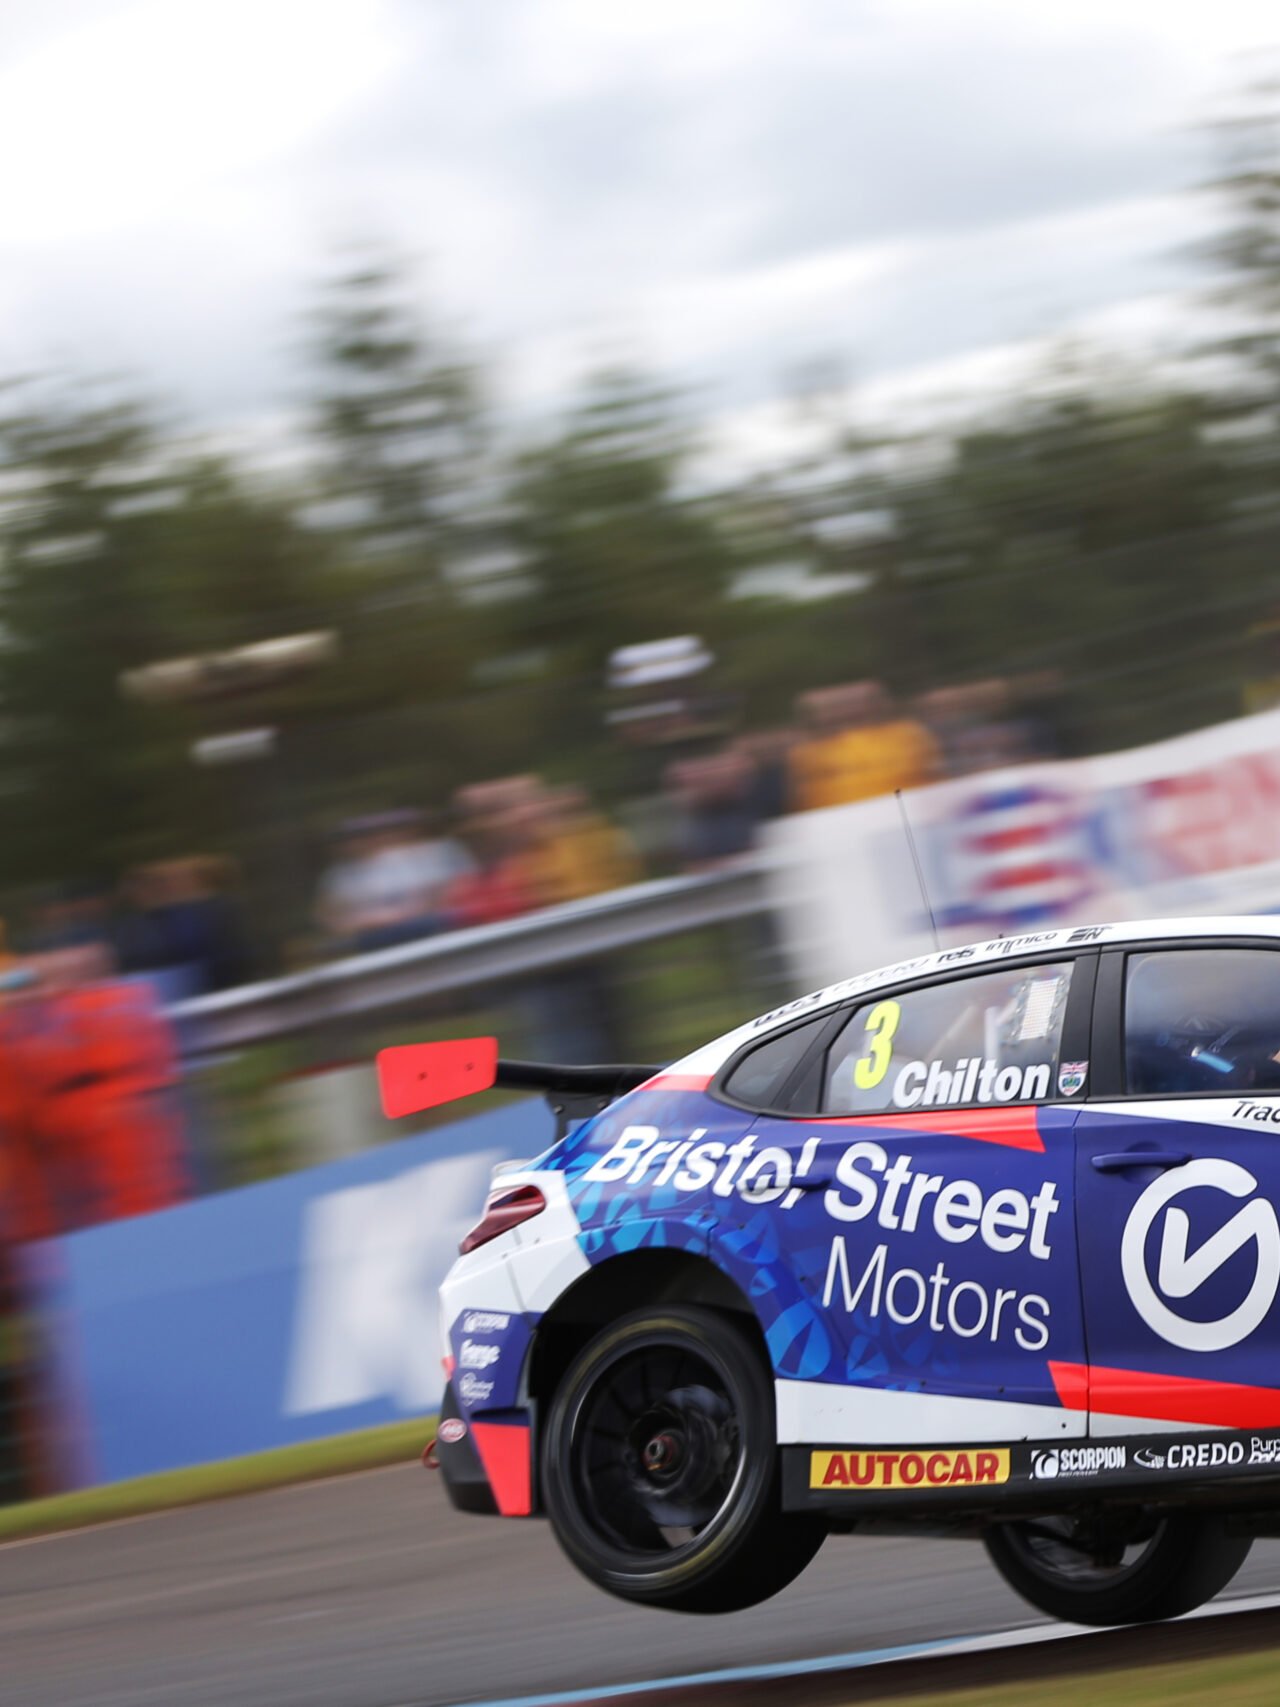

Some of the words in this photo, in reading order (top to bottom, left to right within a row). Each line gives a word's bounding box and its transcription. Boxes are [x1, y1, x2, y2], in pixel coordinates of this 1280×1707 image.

[854, 1000, 900, 1090] 3
[892, 1057, 1051, 1108] Chilton
[582, 1125, 823, 1210] Bristol
[823, 1141, 1060, 1260] Street
[822, 1235, 1052, 1352] Motors
[822, 1452, 1000, 1485] AUTOCAR
[1060, 1445, 1126, 1471] SCORPION
[1167, 1441, 1244, 1469] CREDO
